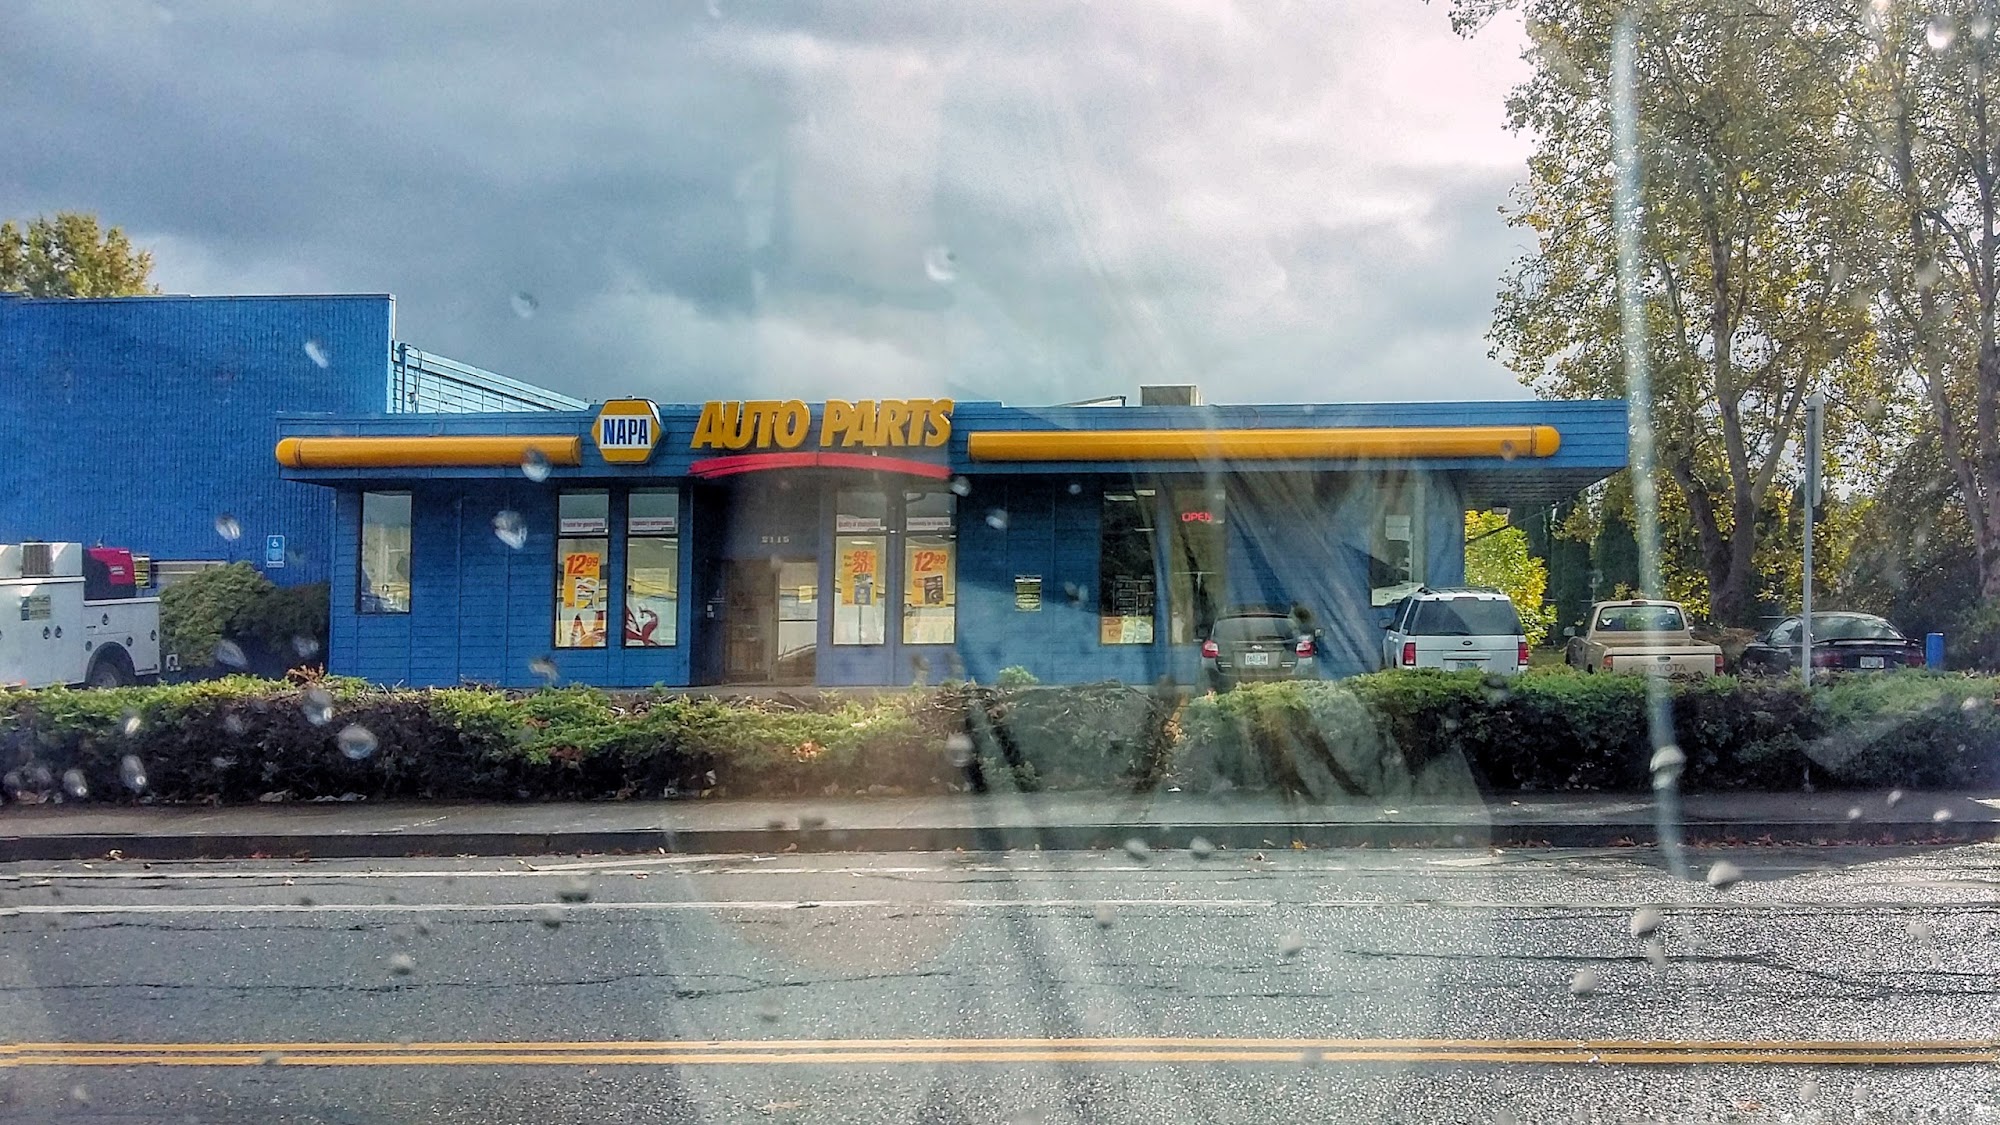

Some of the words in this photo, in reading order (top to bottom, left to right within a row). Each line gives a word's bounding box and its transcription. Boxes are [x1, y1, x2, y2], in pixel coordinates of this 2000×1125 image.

[603, 418, 648, 445] NAPA
[690, 399, 811, 449] AUTO
[819, 397, 955, 447] PARTS
[1181, 512, 1212, 522] OPEN
[1641, 663, 1687, 672] TOYOTA
